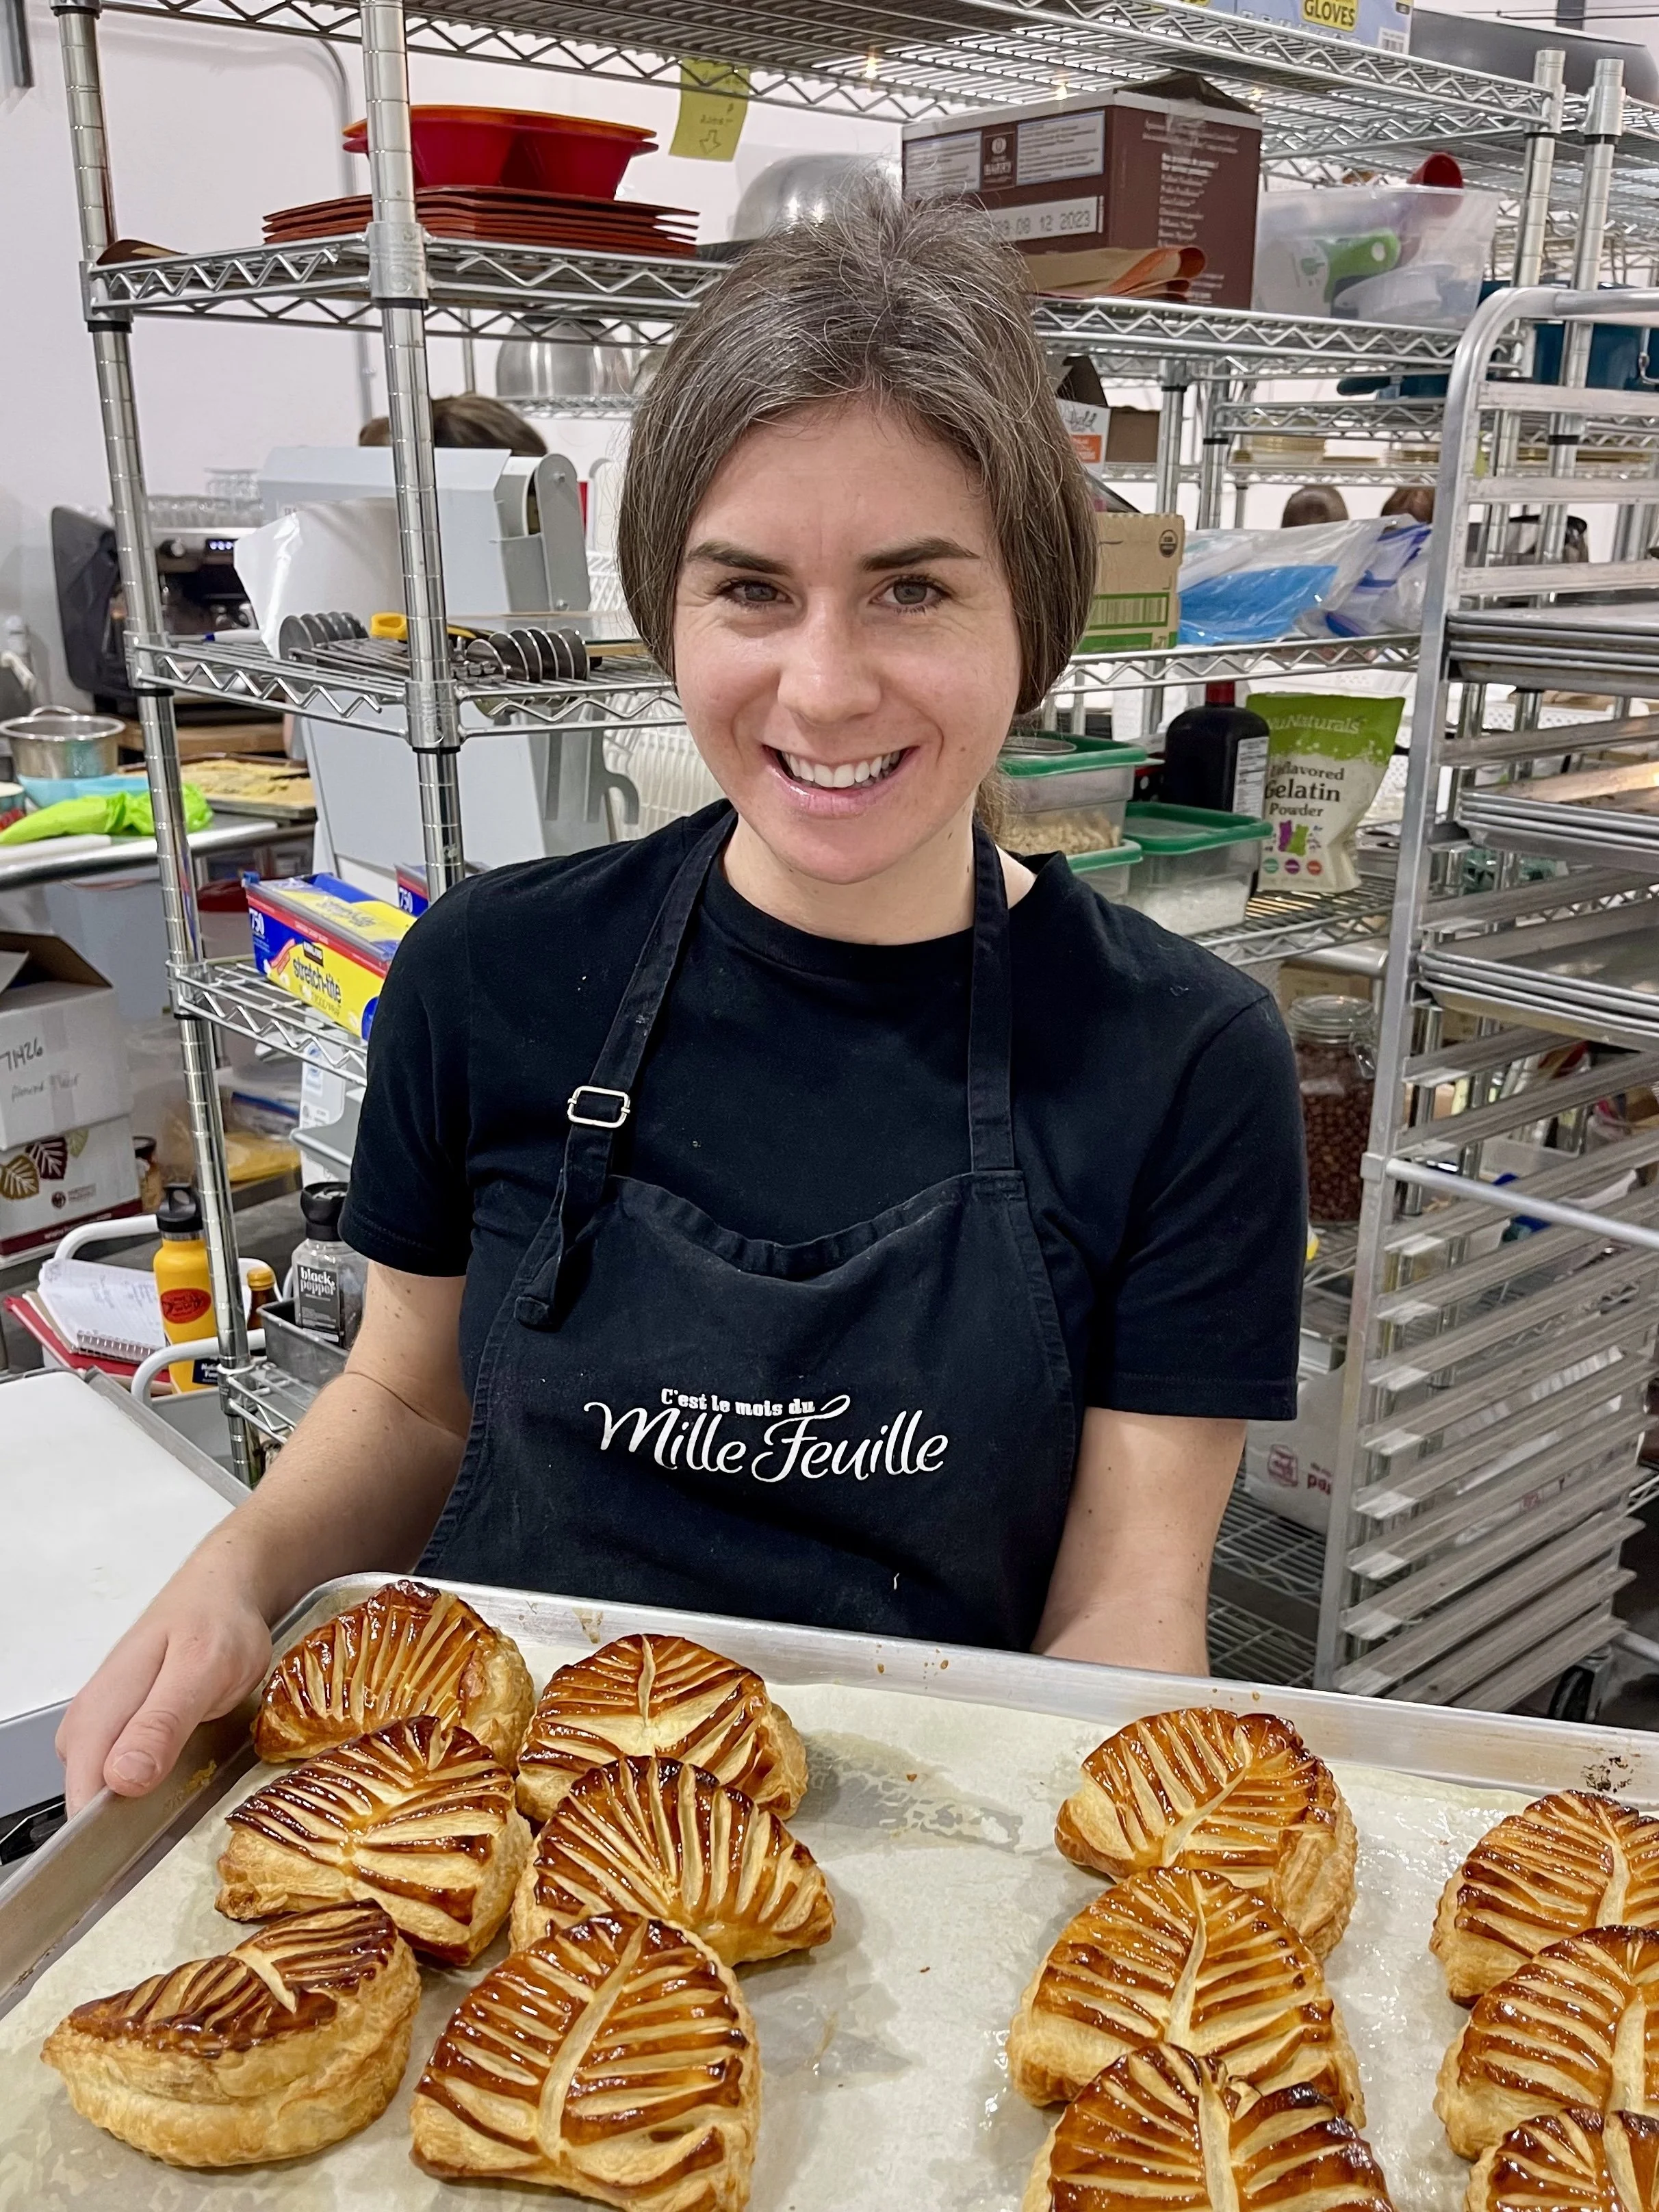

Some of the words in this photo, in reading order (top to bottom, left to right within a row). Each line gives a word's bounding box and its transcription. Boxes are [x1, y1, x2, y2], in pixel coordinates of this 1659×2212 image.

[1304, 0, 1356, 27] GLOVES
[1060, 210, 1091, 231] 2023
[1269, 802, 1324, 817] Powder
[399, 888, 413, 914] 750
[248, 908, 265, 936] 750
[300, 1267, 335, 1287] black
[661, 1388, 708, 1411] C'est
[711, 1395, 730, 1413] le
[735, 1400, 784, 1417] mois
[788, 1398, 815, 1414] du
[583, 1402, 747, 1474] Mille
[751, 1394, 949, 1482] Feuille
